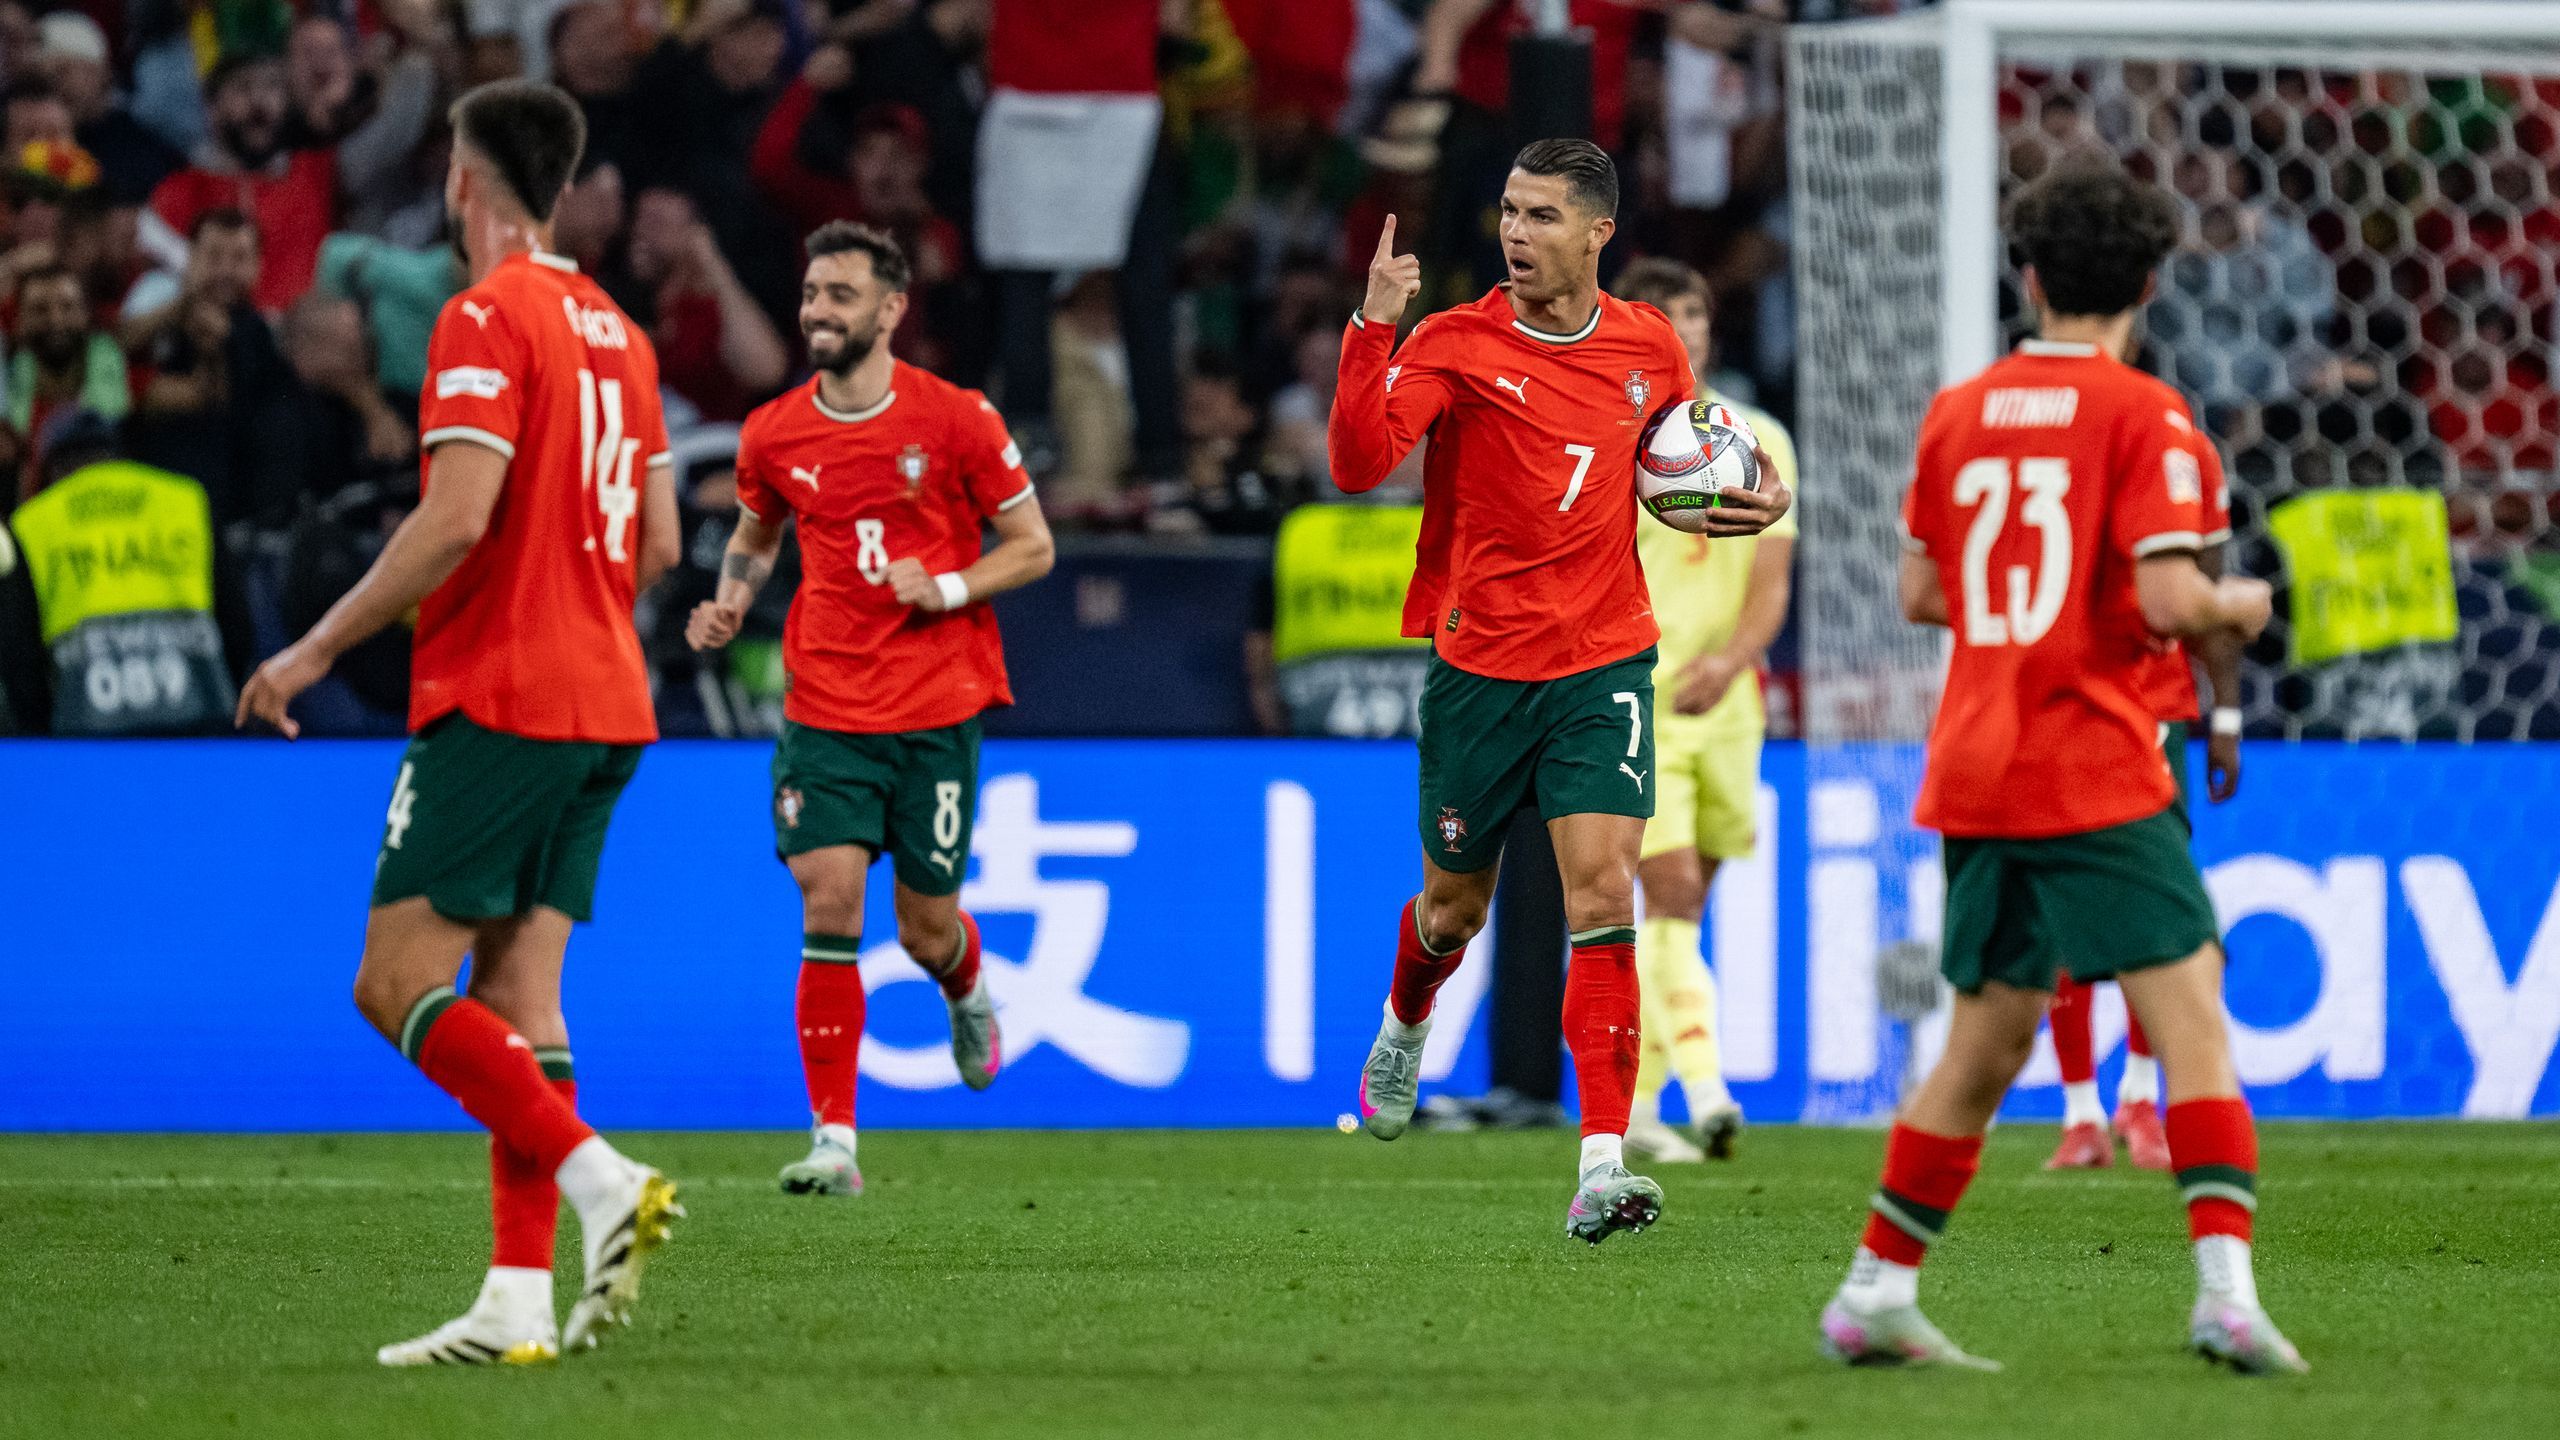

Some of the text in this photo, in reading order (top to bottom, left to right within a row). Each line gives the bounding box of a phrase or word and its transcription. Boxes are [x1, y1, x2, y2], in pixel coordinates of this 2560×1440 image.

[577, 367, 641, 563] 14
[1557, 443, 1597, 512] 7
[1657, 495, 1704, 509] LEAGUE
[855, 518, 889, 587] 8
[1953, 456, 2073, 647] 23
[1612, 691, 1642, 758] 7
[933, 779, 962, 849] 8
[1418, 778, 2560, 1119] liay
